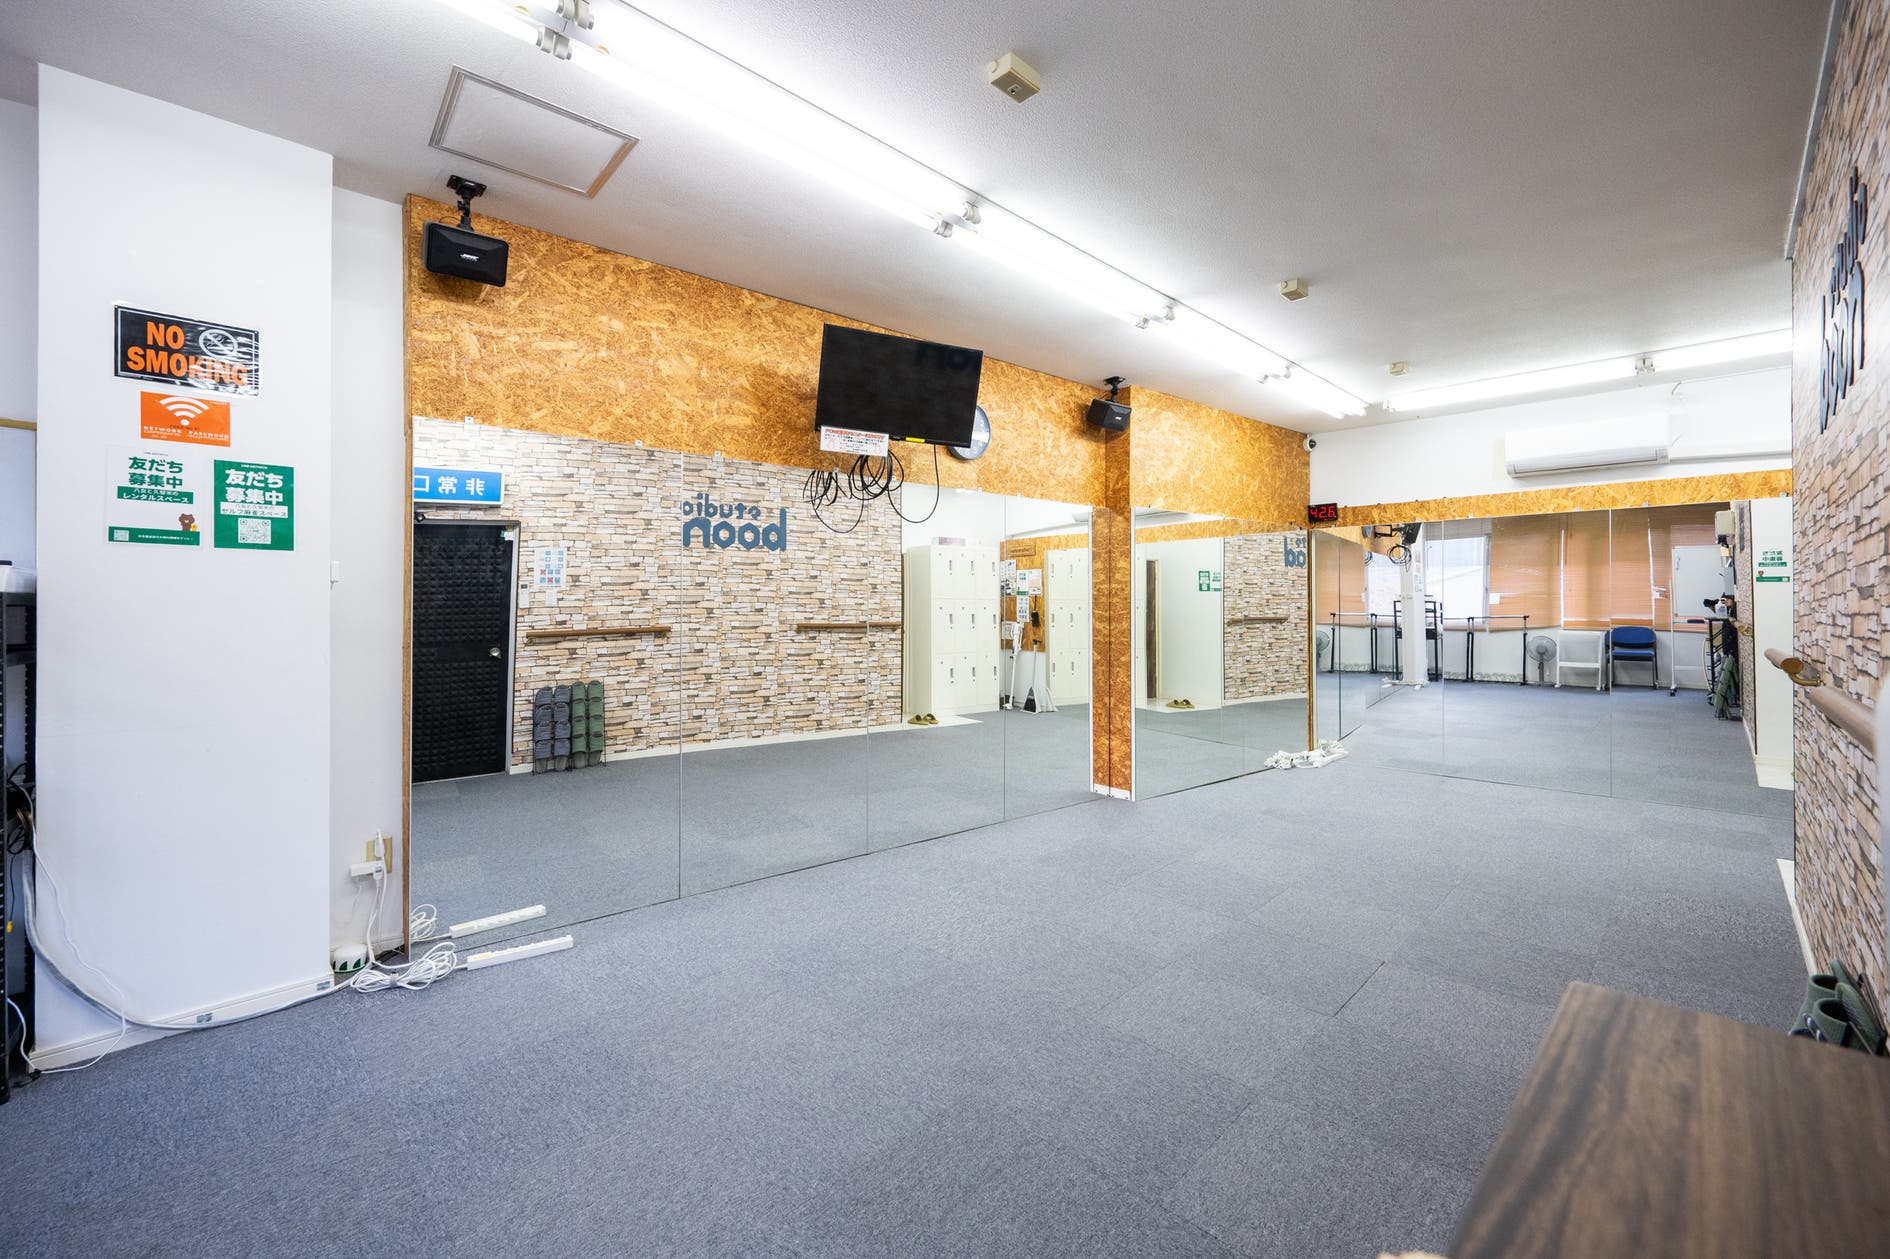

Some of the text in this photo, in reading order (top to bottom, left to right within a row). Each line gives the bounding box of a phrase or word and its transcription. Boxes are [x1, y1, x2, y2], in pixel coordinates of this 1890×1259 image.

[147, 321, 185, 350] NO
[127, 346, 248, 387] SMOKING
[128, 456, 183, 474] 友だち
[128, 472, 183, 489] 募集中
[225, 469, 283, 488] 友だち
[123, 493, 189, 503] レンタルスペース
[225, 486, 283, 505] 募集中
